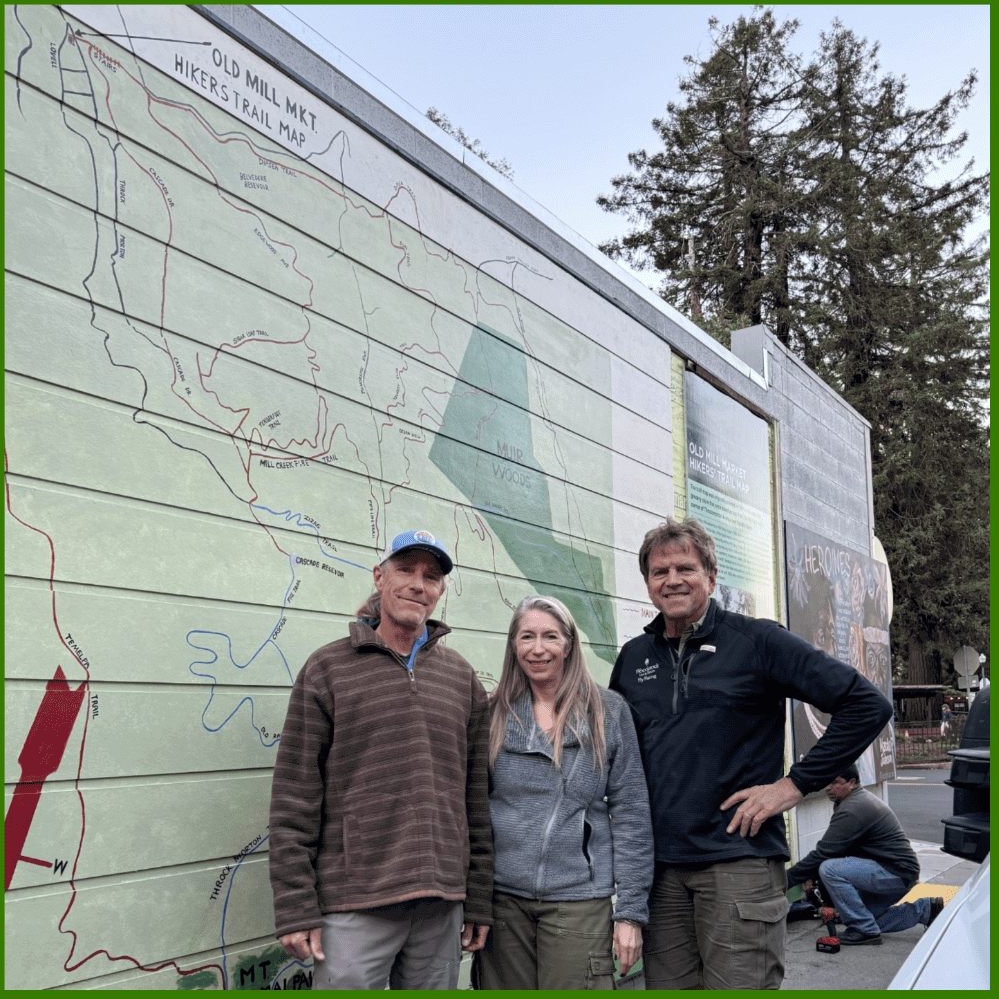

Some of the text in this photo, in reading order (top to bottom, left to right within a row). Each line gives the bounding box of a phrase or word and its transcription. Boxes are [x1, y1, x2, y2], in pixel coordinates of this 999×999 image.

[93, 52, 117, 73] STAIRS
[174, 54, 306, 148] HIKERS TRAIL MAP
[212, 48, 318, 133] OLD MILL MKT.
[240, 172, 267, 182] BELVEDERE
[259, 158, 297, 177] DIPSEA TRAIL
[149, 167, 169, 197] CASCADE
[244, 181, 269, 191] RESEVOIR
[254, 227, 277, 255] EDGEWOOD
[259, 454, 338, 469] MILL CREEK TRAIL
[496, 440, 524, 463] MUIR
[689, 442, 746, 480] OLD MILL MARKET
[492, 462, 532, 489] WOODS
[717, 470, 735, 489] TRAIL
[737, 480, 749, 492] MAP
[322, 537, 338, 552] TRAIL
[295, 556, 345, 579] CASCADE RESEVOIR
[272, 616, 287, 640] CASCADE
[64, 633, 100, 720] TEMELPA TRAIL
[260, 726, 269, 738] OLD
[53, 859, 68, 875] W
[210, 835, 262, 901] THROCK MORTON
